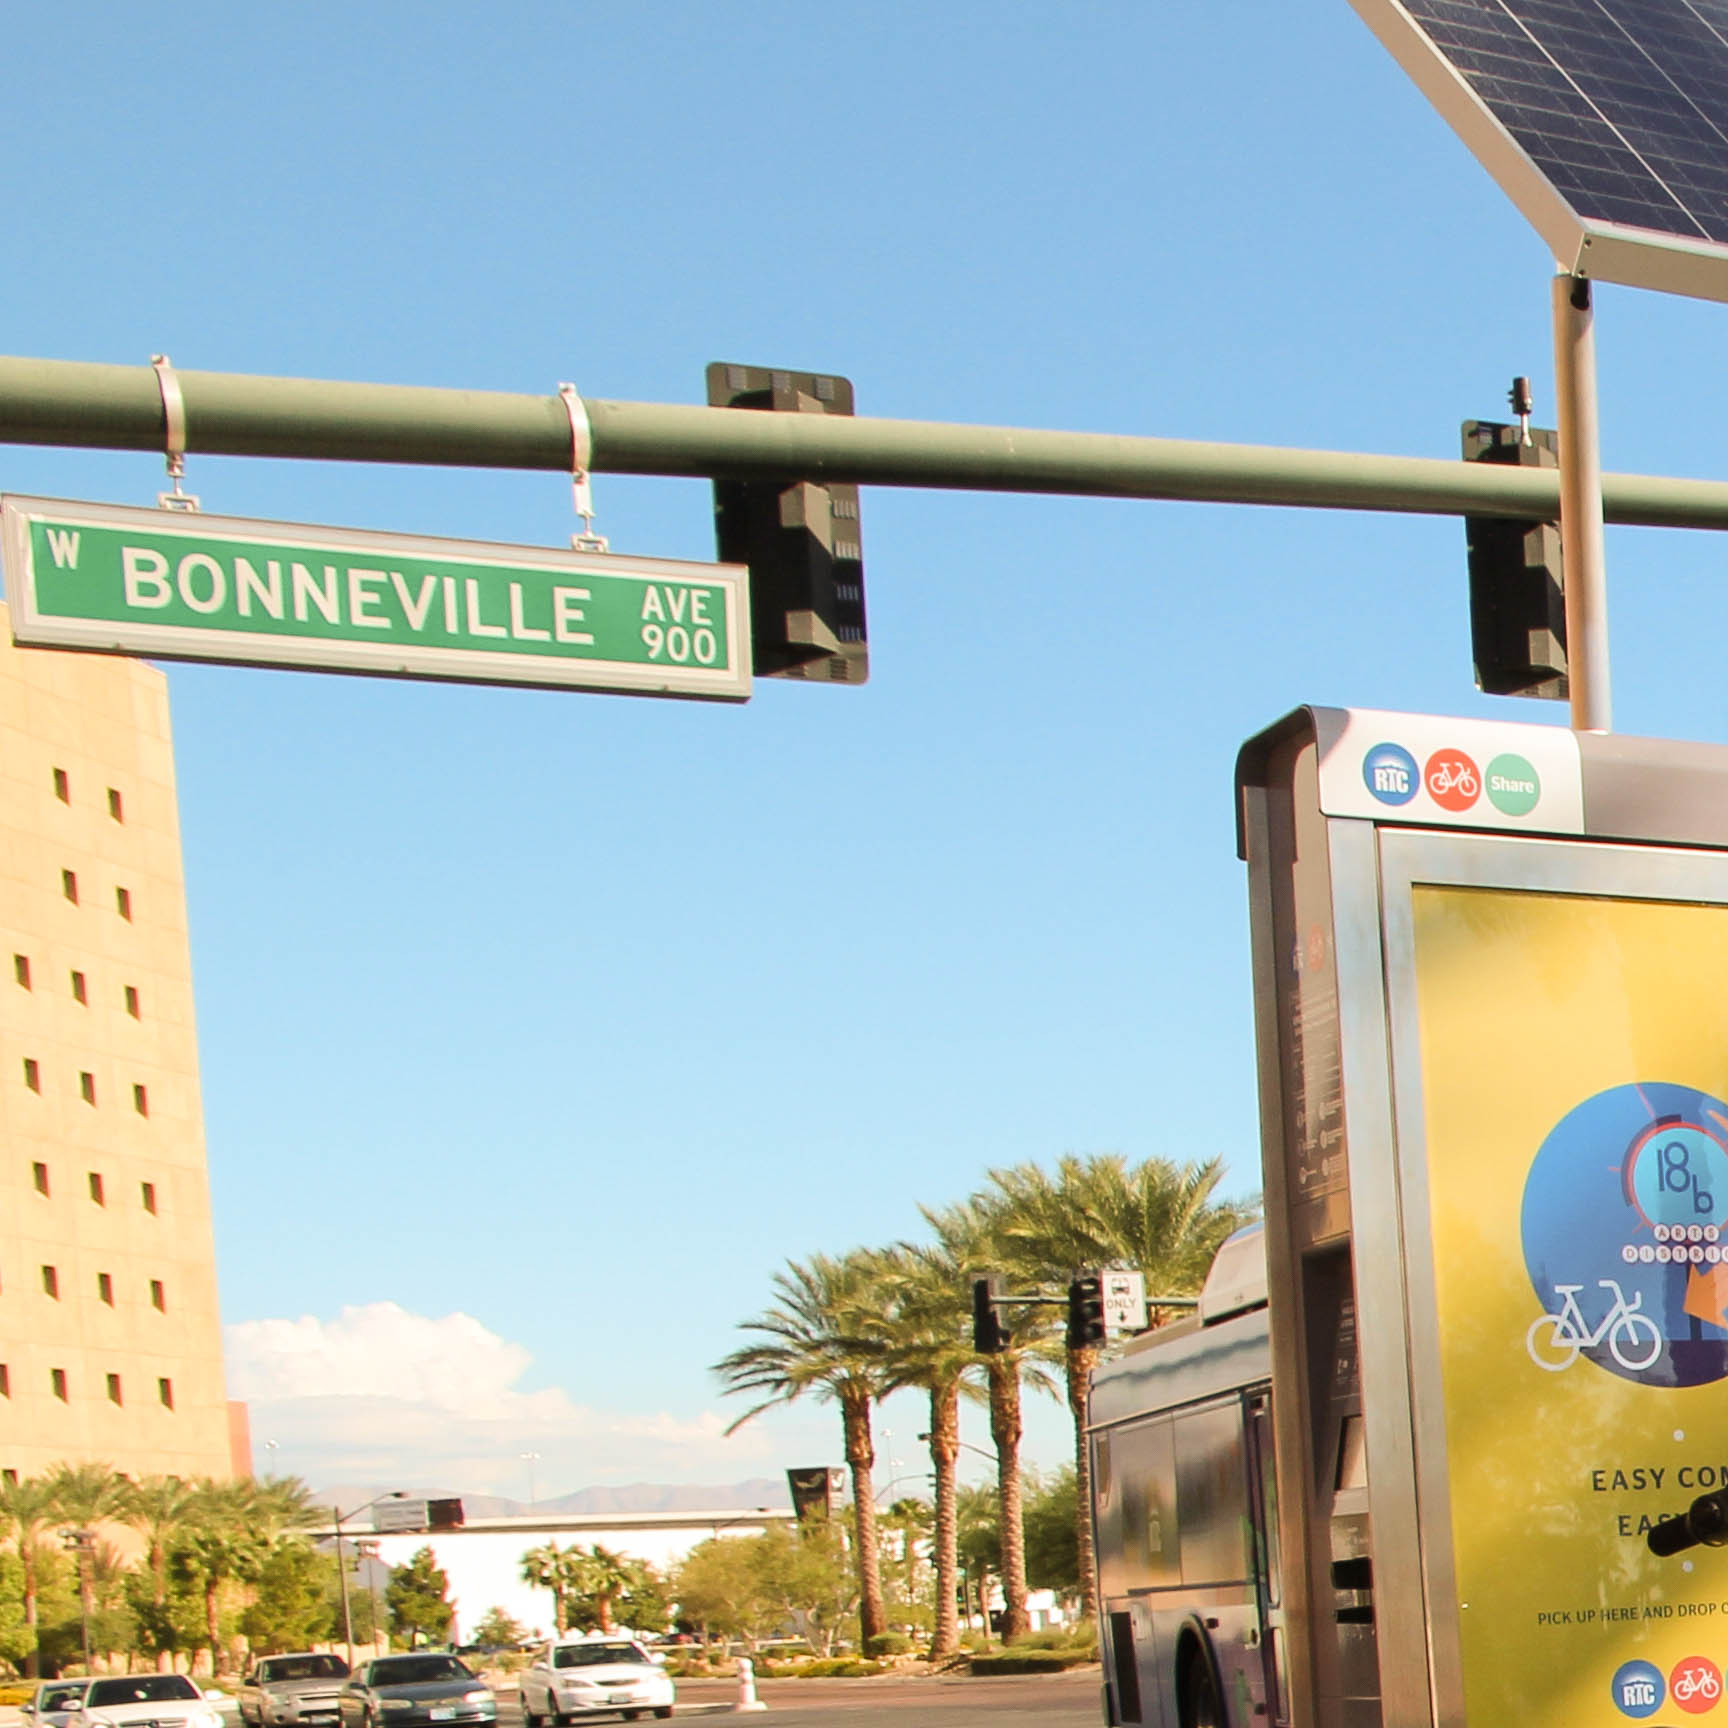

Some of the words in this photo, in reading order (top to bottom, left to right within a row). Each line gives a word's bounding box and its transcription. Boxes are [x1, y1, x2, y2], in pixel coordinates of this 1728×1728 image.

[46, 529, 82, 571] W
[121, 546, 596, 646] BONNEVILLE
[641, 585, 714, 627] AVE
[641, 624, 718, 665] 900
[1373, 767, 1410, 794] RTC
[1490, 775, 1536, 794] Share
[1657, 1226, 1717, 1241] ARTS
[1106, 1298, 1136, 1310] ONLY
[1592, 1468, 1665, 1491] EASY
[1538, 1611, 1572, 1625] PICK
[1576, 1610, 1596, 1624] UP
[1600, 1607, 1639, 1622] HERE
[1642, 1604, 1674, 1619] AND
[1678, 1602, 1718, 1618] DROP
[1622, 1683, 1656, 1707] RTC
